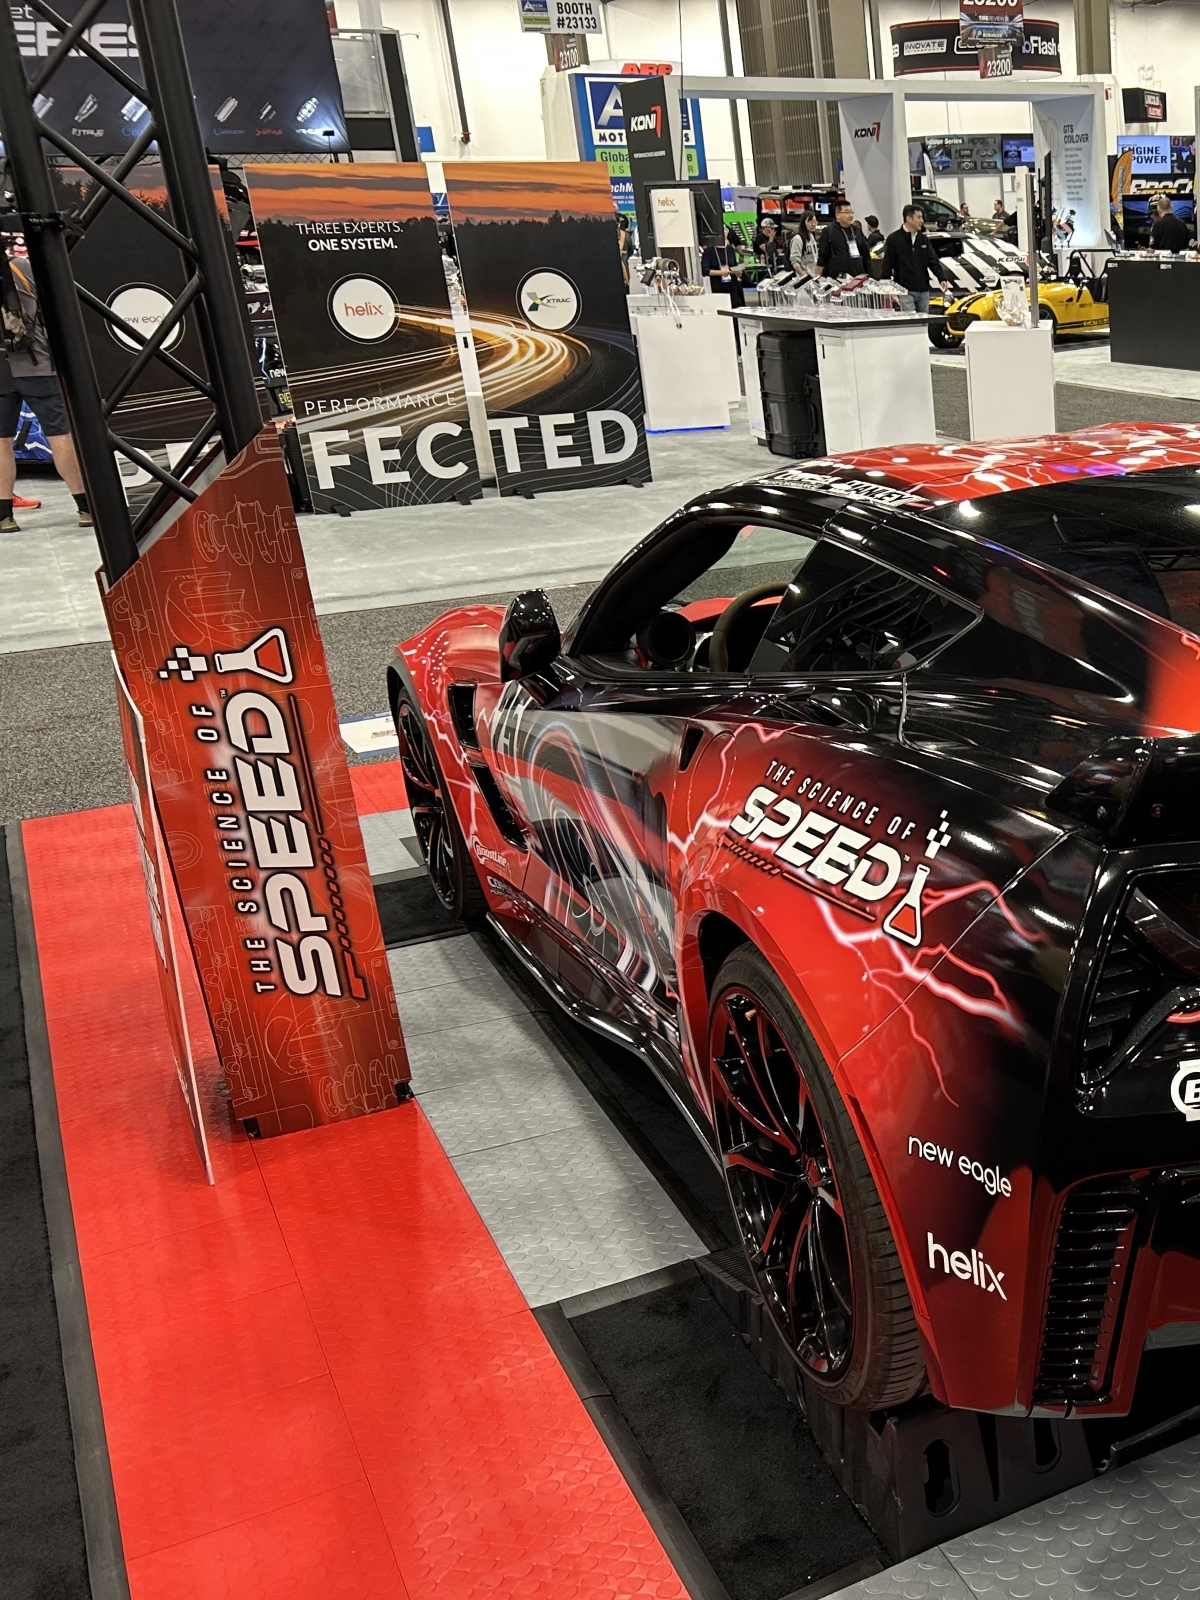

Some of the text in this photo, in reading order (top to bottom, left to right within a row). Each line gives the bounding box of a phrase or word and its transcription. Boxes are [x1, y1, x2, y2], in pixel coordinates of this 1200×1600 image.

[557, 2, 592, 15] BOOTH
[557, 17, 597, 30] #23133
[560, 48, 579, 69] 23100
[987, 58, 1010, 77] 23200
[630, 111, 659, 133] KONI
[854, 125, 879, 139] KONI
[1063, 124, 1074, 133] GTS
[1064, 133, 1089, 144] COILOVER
[295, 221, 404, 234] THREE EXPERTS.
[308, 237, 398, 251] ONE SYSTEM.
[344, 302, 384, 316] helix
[304, 391, 457, 415] PERFORMANCE
[766, 760, 916, 840] THE SCIENCE OF
[191, 704, 276, 994] THE SCIENCE OF
[224, 692, 341, 997] SPEED
[729, 786, 901, 901] SPEED
[908, 1136, 1012, 1197] new eagle
[927, 1231, 1008, 1301] helix
